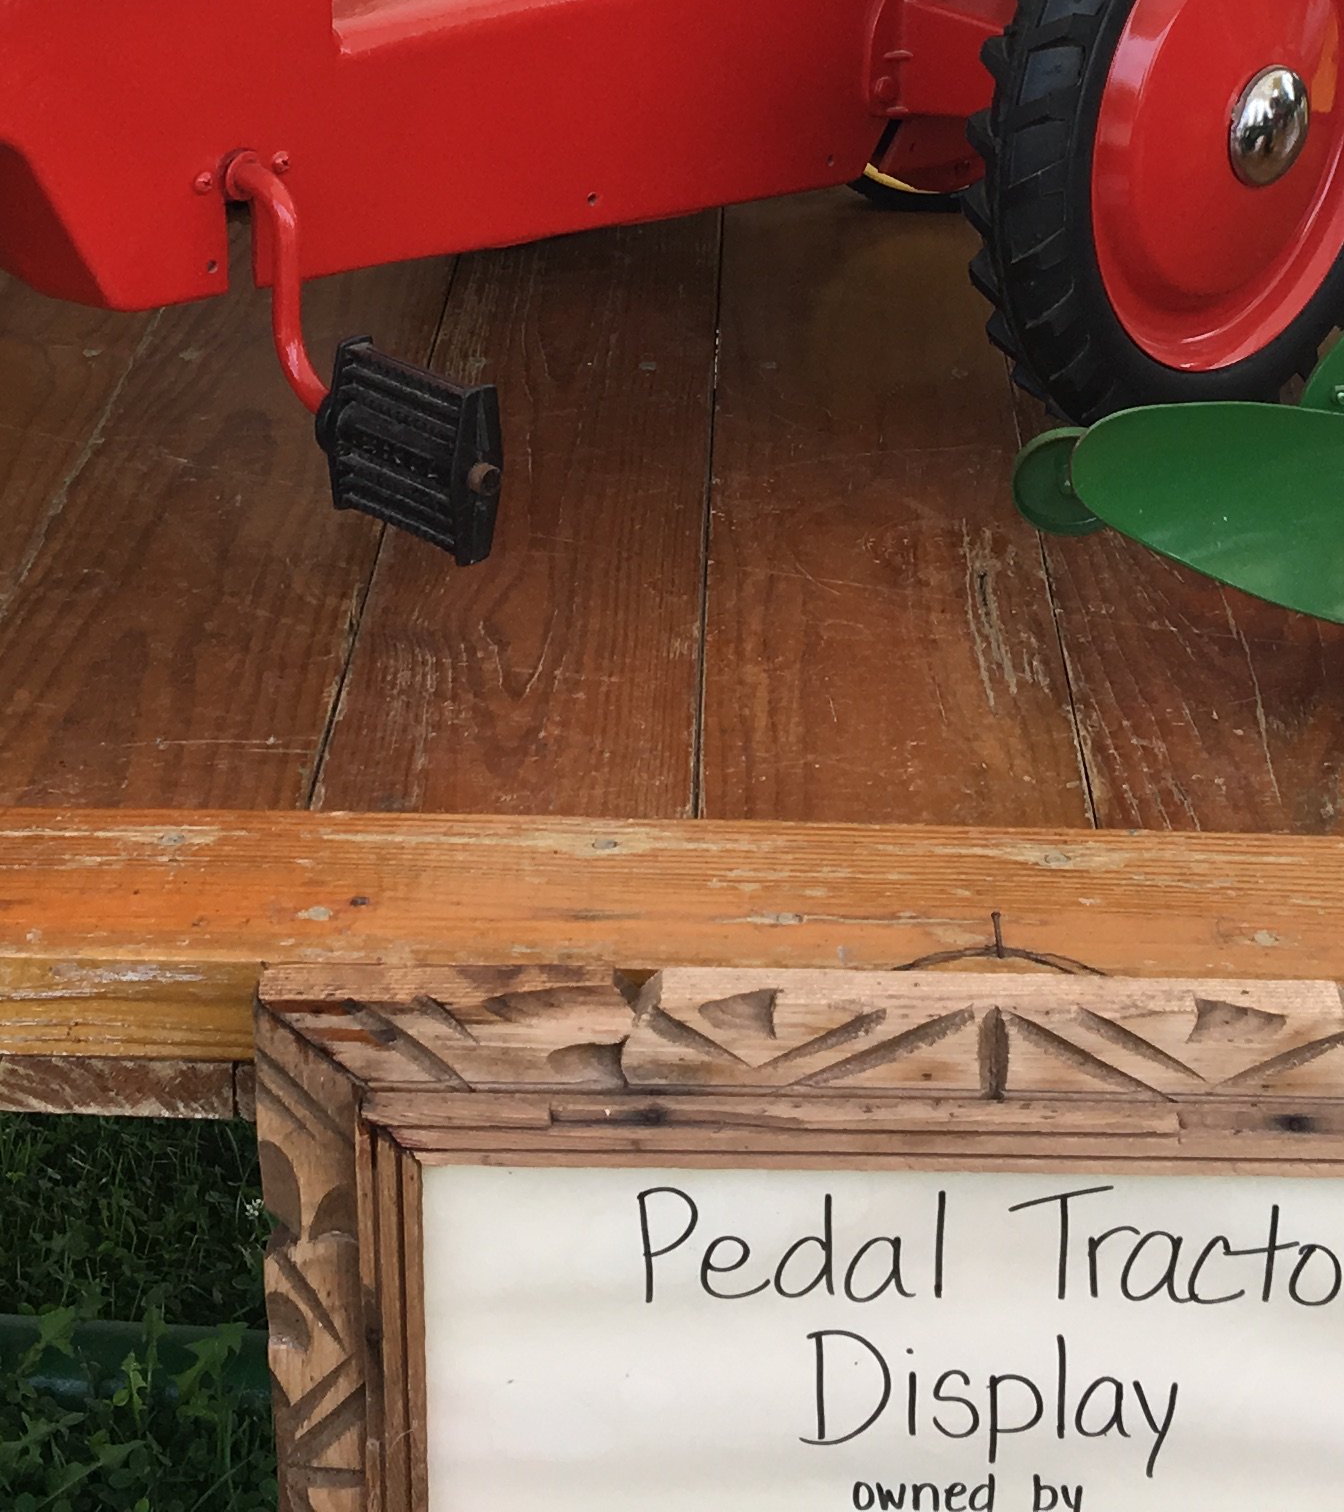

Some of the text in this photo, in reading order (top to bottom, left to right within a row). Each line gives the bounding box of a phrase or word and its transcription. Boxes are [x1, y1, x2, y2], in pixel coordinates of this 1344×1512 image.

[637, 1186, 946, 1303] Pedal
[798, 1329, 1179, 1478] Display
[852, 1472, 1084, 1512] owned by
